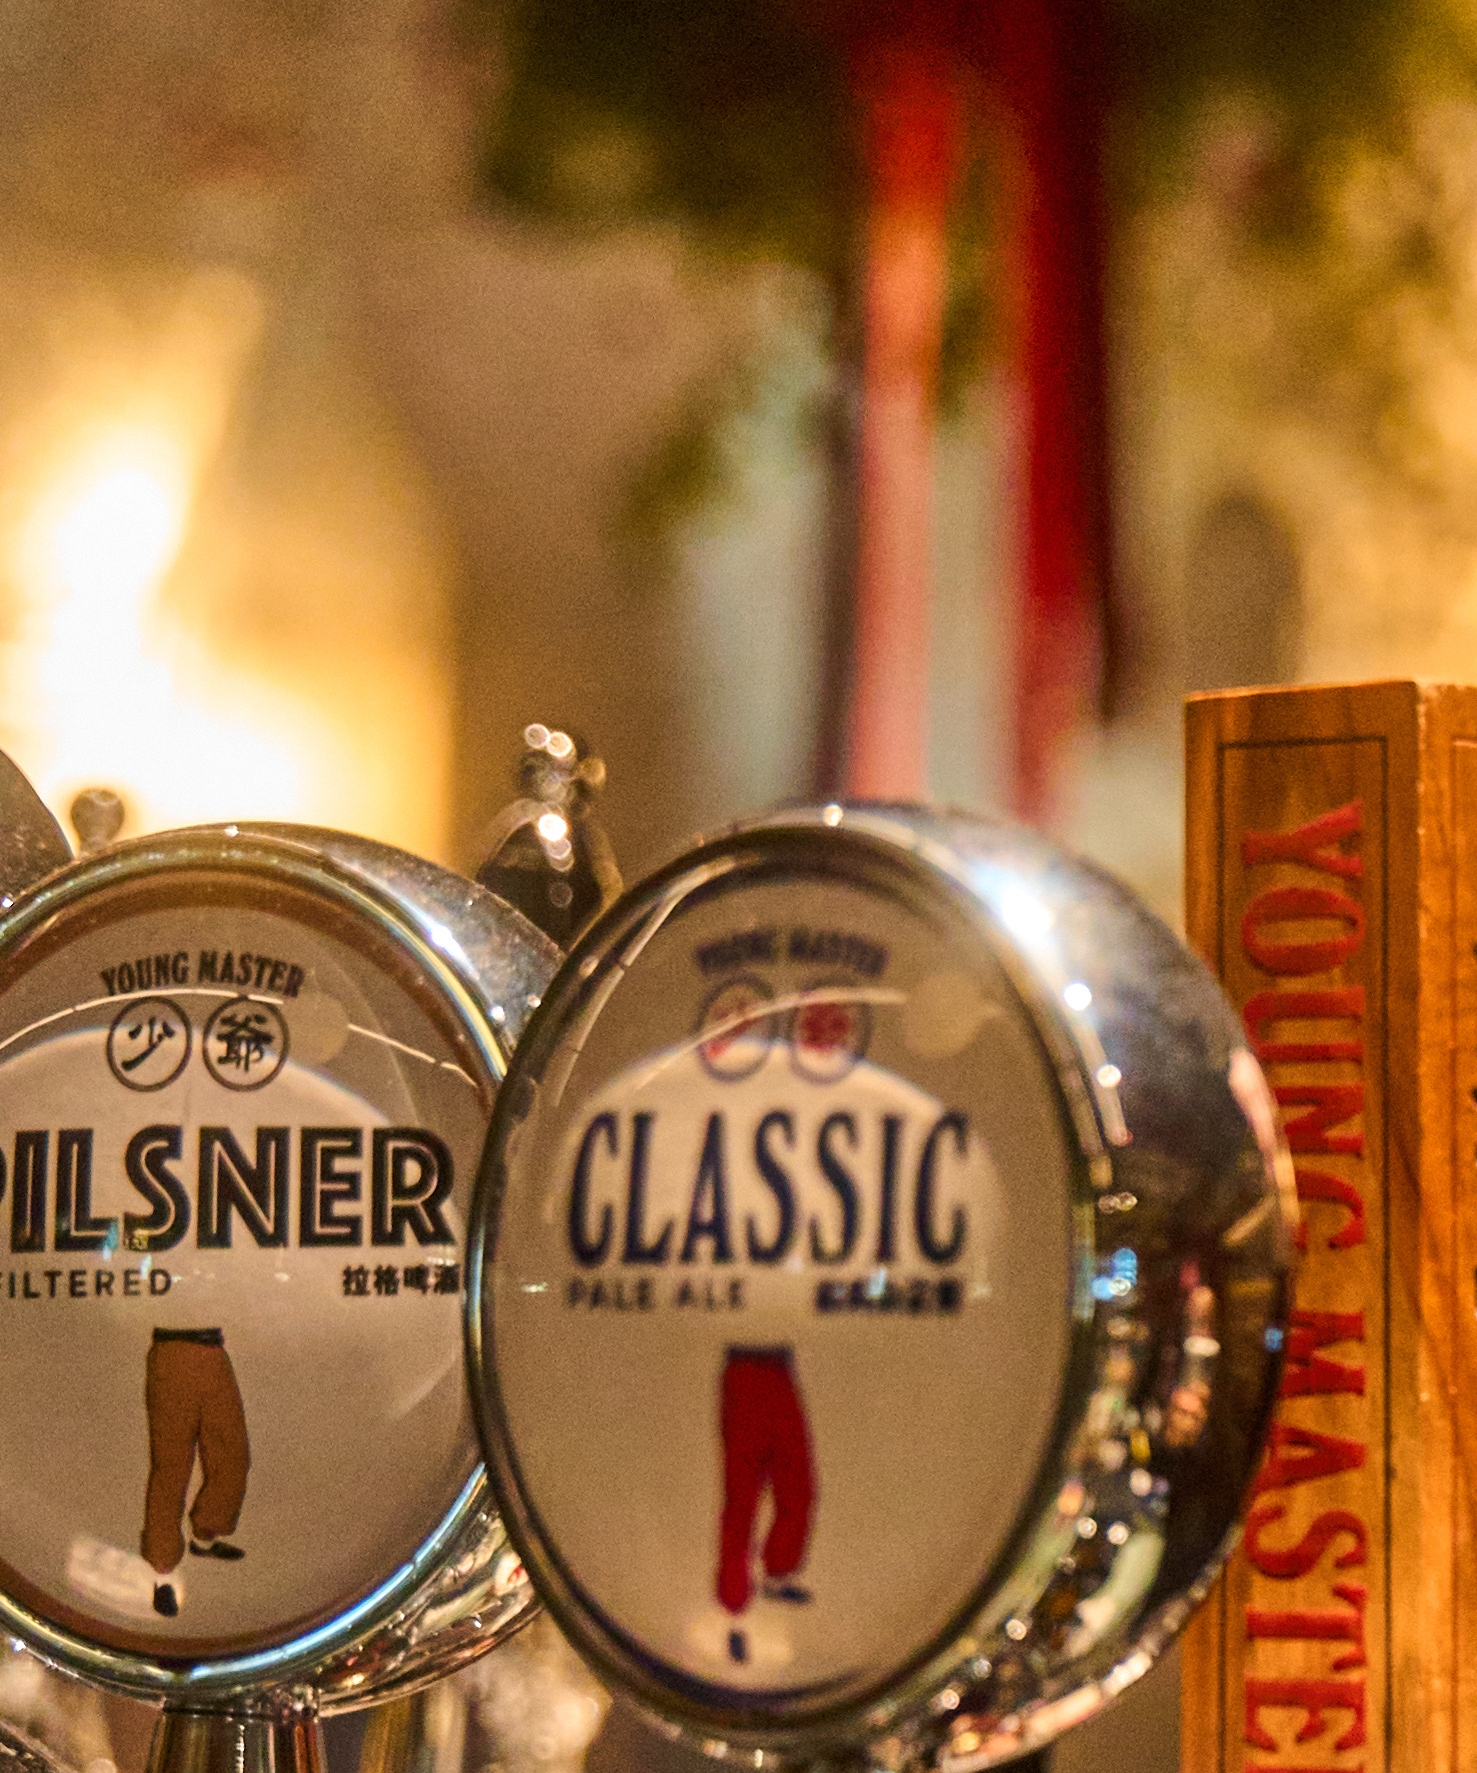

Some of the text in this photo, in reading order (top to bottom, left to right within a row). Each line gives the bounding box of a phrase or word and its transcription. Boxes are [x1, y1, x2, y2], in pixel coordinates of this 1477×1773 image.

[101, 950, 304, 998] YOUNG MASTER
[1240, 797, 1366, 1252] YOUNG
[0, 1124, 456, 1253] ILSNER
[568, 1109, 971, 1269] CLASSIC
[0, 1268, 173, 1298] ILTERED
[342, 1264, 460, 1296] 拉格啤酒
